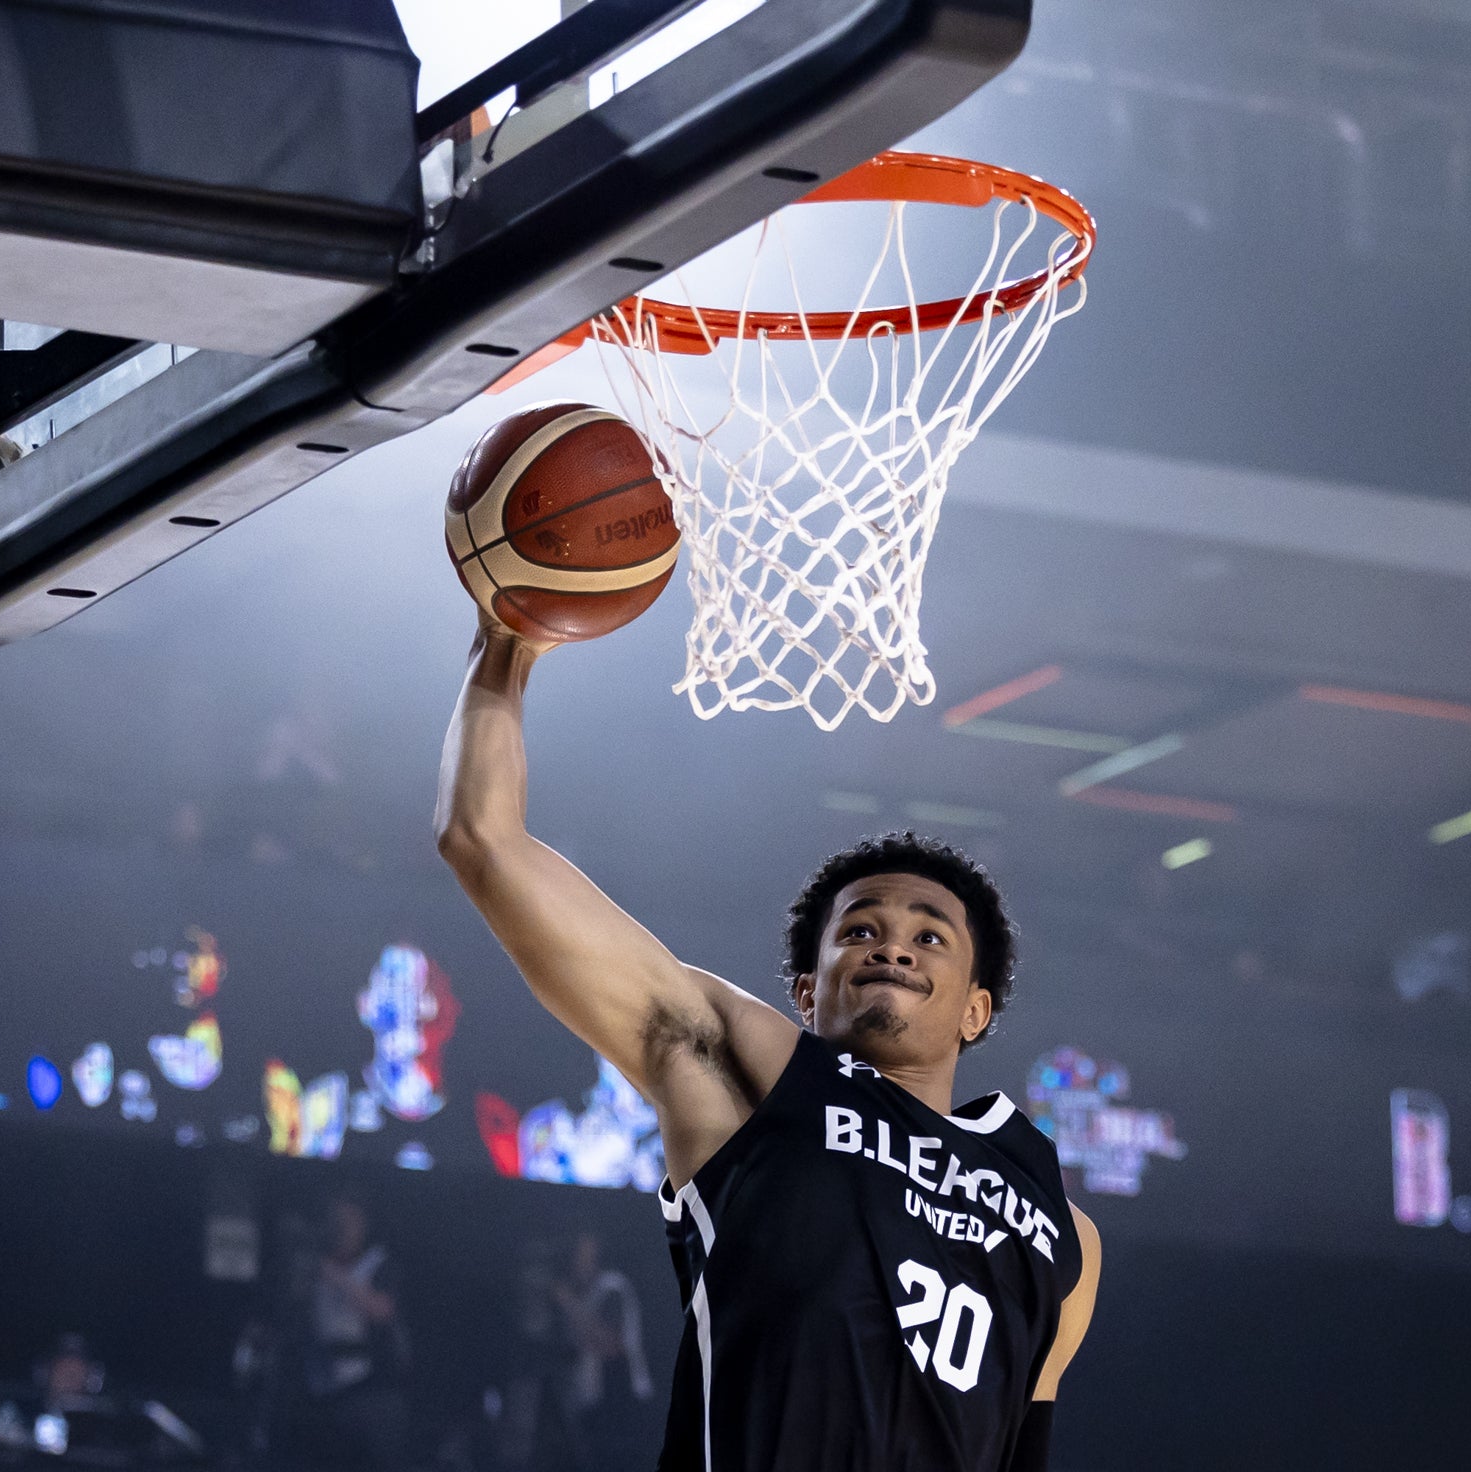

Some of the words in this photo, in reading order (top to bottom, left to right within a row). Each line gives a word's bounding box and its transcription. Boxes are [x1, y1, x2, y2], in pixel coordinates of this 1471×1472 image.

[594, 503, 674, 546] molten
[825, 1105, 1060, 1264] B.LEAGUE
[904, 1188, 986, 1247] UNITED
[895, 1258, 994, 1393] 20
